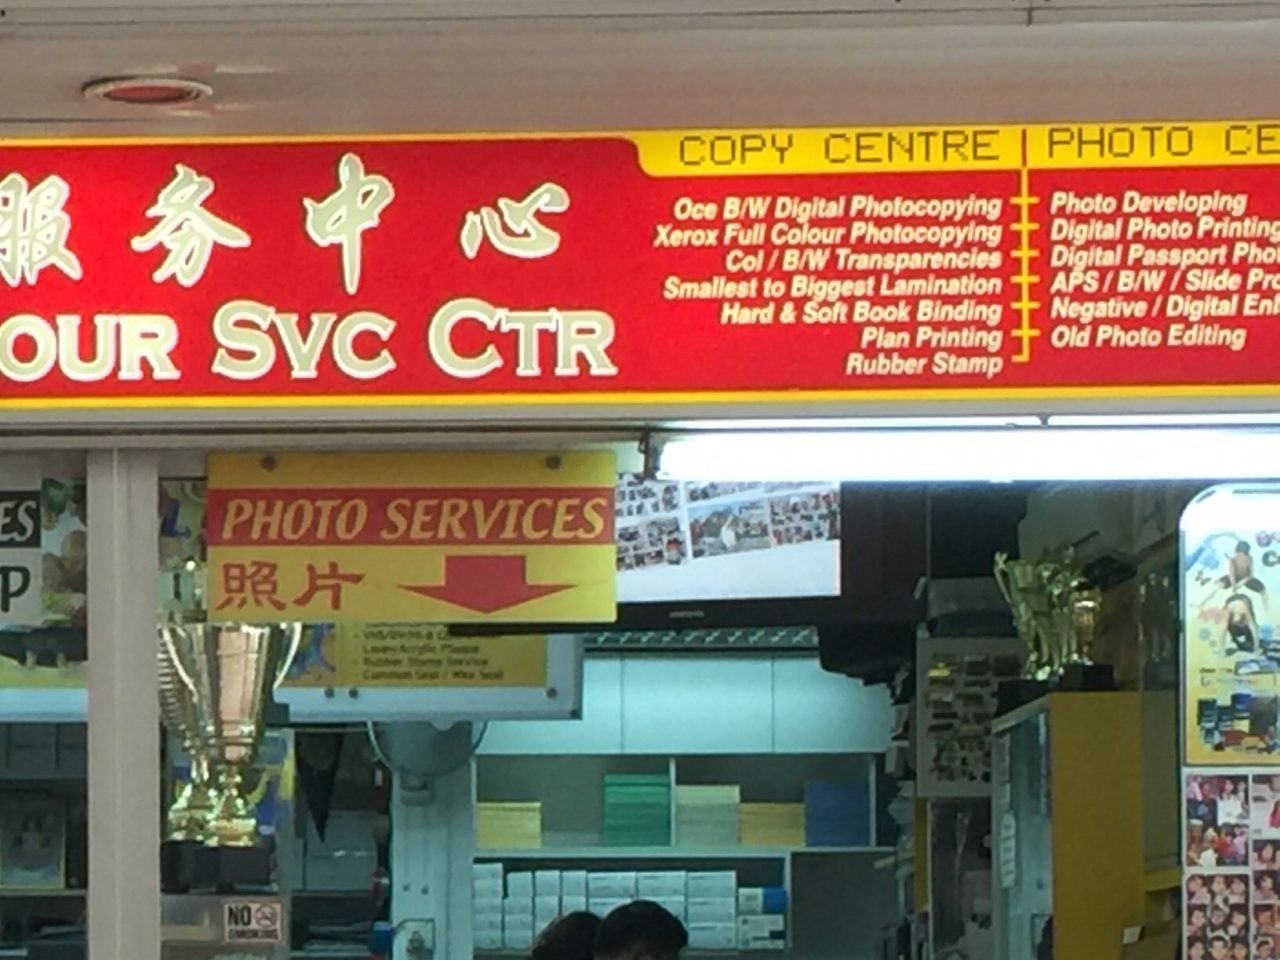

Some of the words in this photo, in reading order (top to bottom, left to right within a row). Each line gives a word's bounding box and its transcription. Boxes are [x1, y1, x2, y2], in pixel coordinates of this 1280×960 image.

[678, 134, 794, 166] COPY
[823, 130, 1000, 163] CENTRE
[1048, 126, 1194, 159] PHOTO
[1225, 124, 1280, 155] CE
[673, 198, 718, 221] Oce
[722, 197, 771, 220] B/W
[774, 196, 845, 224] Digital
[849, 194, 1003, 223] Photocopying
[1050, 191, 1117, 214] Photo
[1122, 190, 1248, 217] Developing
[653, 225, 718, 248] Xerox
[723, 224, 765, 246] Full
[770, 224, 846, 246] Colour
[849, 221, 1003, 249] Photocopying
[1050, 218, 1122, 246] Digital
[1126, 217, 1193, 241] Photo
[1197, 215, 1280, 243] Printing
[725, 249, 764, 272] Col
[767, 250, 778, 271] /
[781, 248, 831, 271] B/W
[835, 246, 1003, 273] Transparencies
[1050, 245, 1122, 271] Digital
[1127, 244, 1228, 269] Passport
[1232, 241, 1280, 265] Pho
[663, 276, 757, 299] Smallest
[763, 278, 785, 298] to
[790, 275, 876, 302] Biggest
[879, 273, 1003, 297] Lamination
[1050, 271, 1099, 294] APS
[1102, 271, 1115, 293] /
[1117, 270, 1167, 293] B/W
[1169, 270, 1182, 292] /
[1185, 268, 1242, 292] Slide
[721, 302, 775, 325] Hard
[779, 303, 797, 324] &
[802, 302, 848, 324] Soft
[852, 301, 912, 323] Book
[916, 299, 1003, 326] Binding
[1050, 296, 1148, 323] Negative
[1151, 294, 1163, 318] /
[1166, 295, 1239, 321] Digital
[211, 299, 398, 380] SVC
[428, 297, 618, 379] CTR
[861, 327, 910, 349] Plan
[915, 325, 1003, 353] Printing
[1051, 325, 1092, 348] Old
[1096, 325, 1162, 348] Photo
[1167, 323, 1247, 351] Editing
[846, 353, 927, 375] Rubber
[931, 352, 1004, 379] Stamp
[222, 498, 368, 541] PHOTO
[380, 496, 607, 541] SERVICES
[214, 560, 366, 611] 照片
[227, 904, 252, 926] NO
